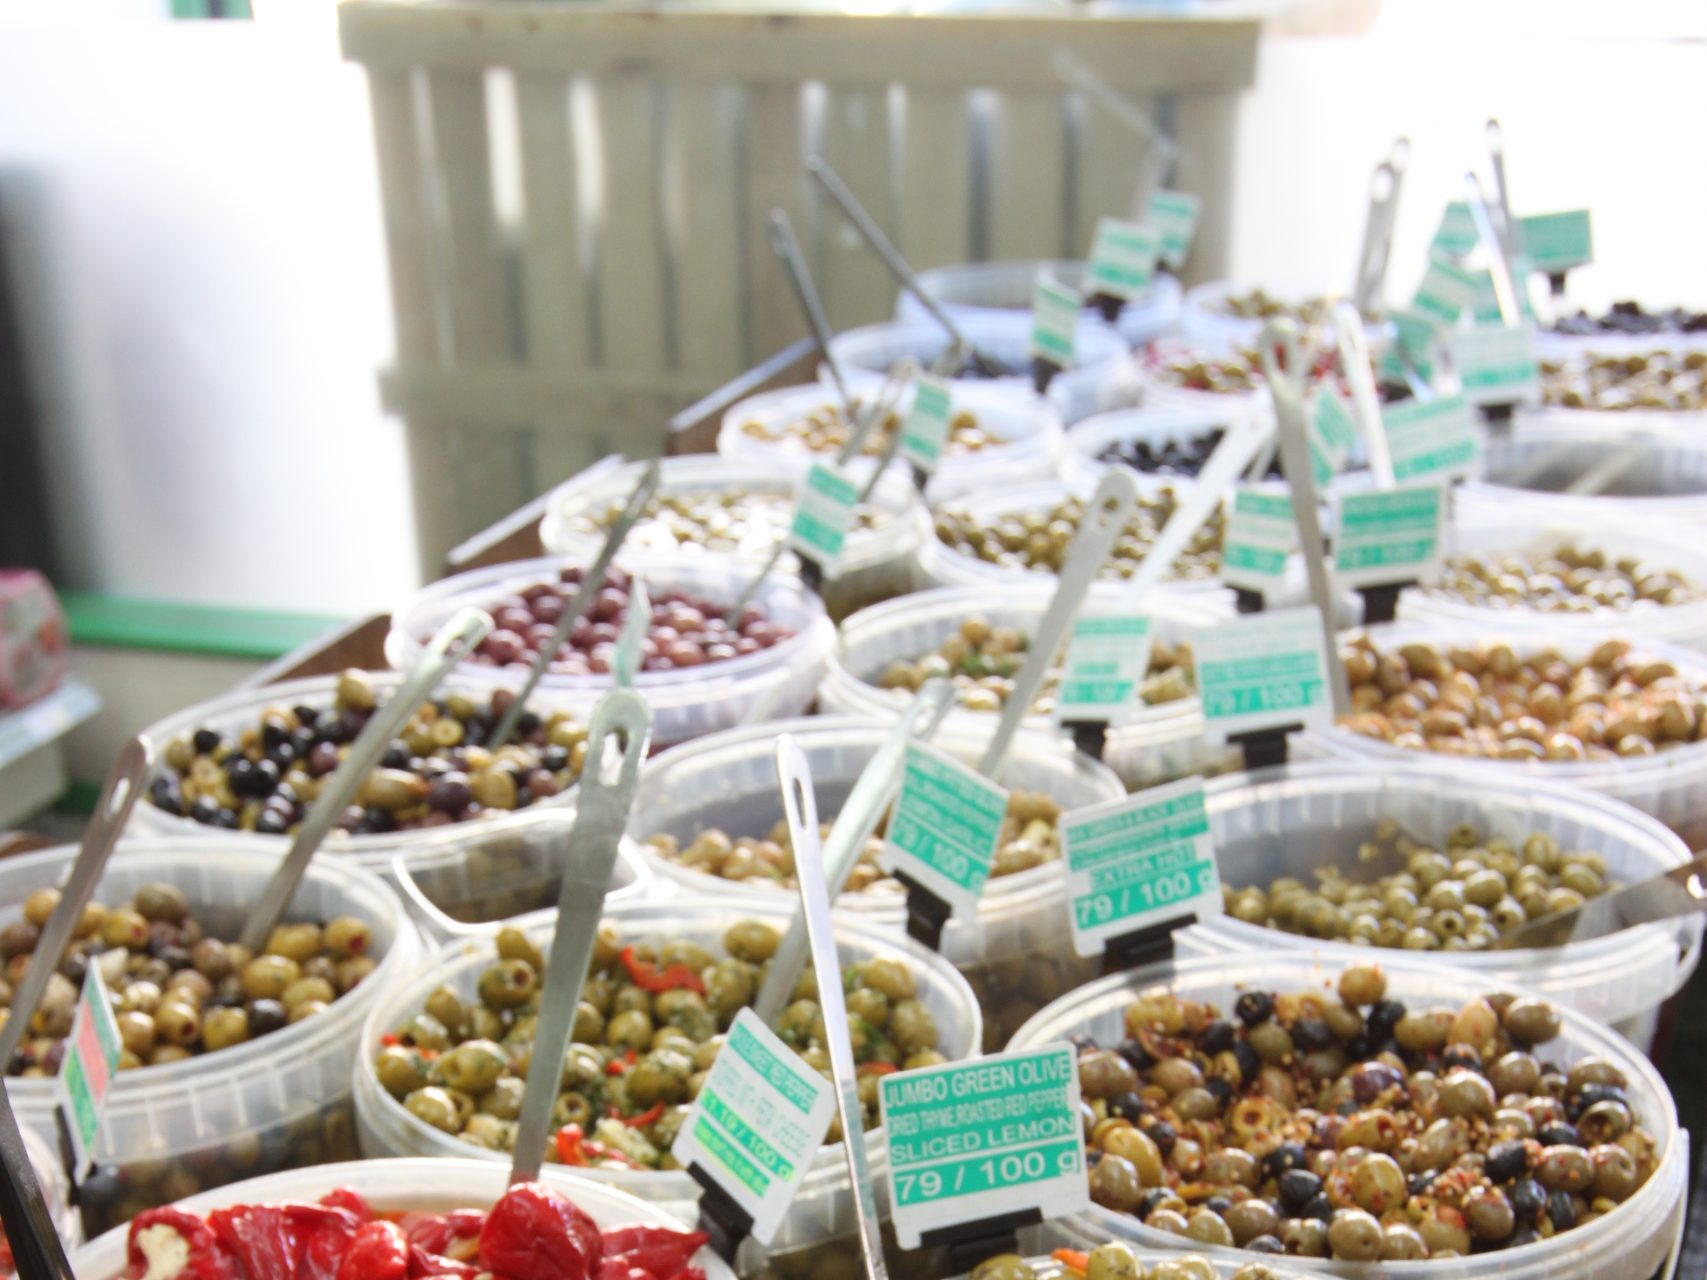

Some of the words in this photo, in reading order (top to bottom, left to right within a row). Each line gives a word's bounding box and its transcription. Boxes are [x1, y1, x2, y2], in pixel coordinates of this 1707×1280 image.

[1076, 895, 1113, 925] 79
[1141, 871, 1191, 906] 100
[884, 1076, 948, 1110] JUMBO
[951, 1065, 1016, 1097] GREEN
[1018, 1055, 1073, 1086] OLIVE
[890, 1131, 981, 1163] SLICED
[987, 1115, 1075, 1146] LEMON
[895, 1170, 943, 1202] 79
[953, 1164, 966, 1192] /
[979, 1151, 1046, 1185] 100
